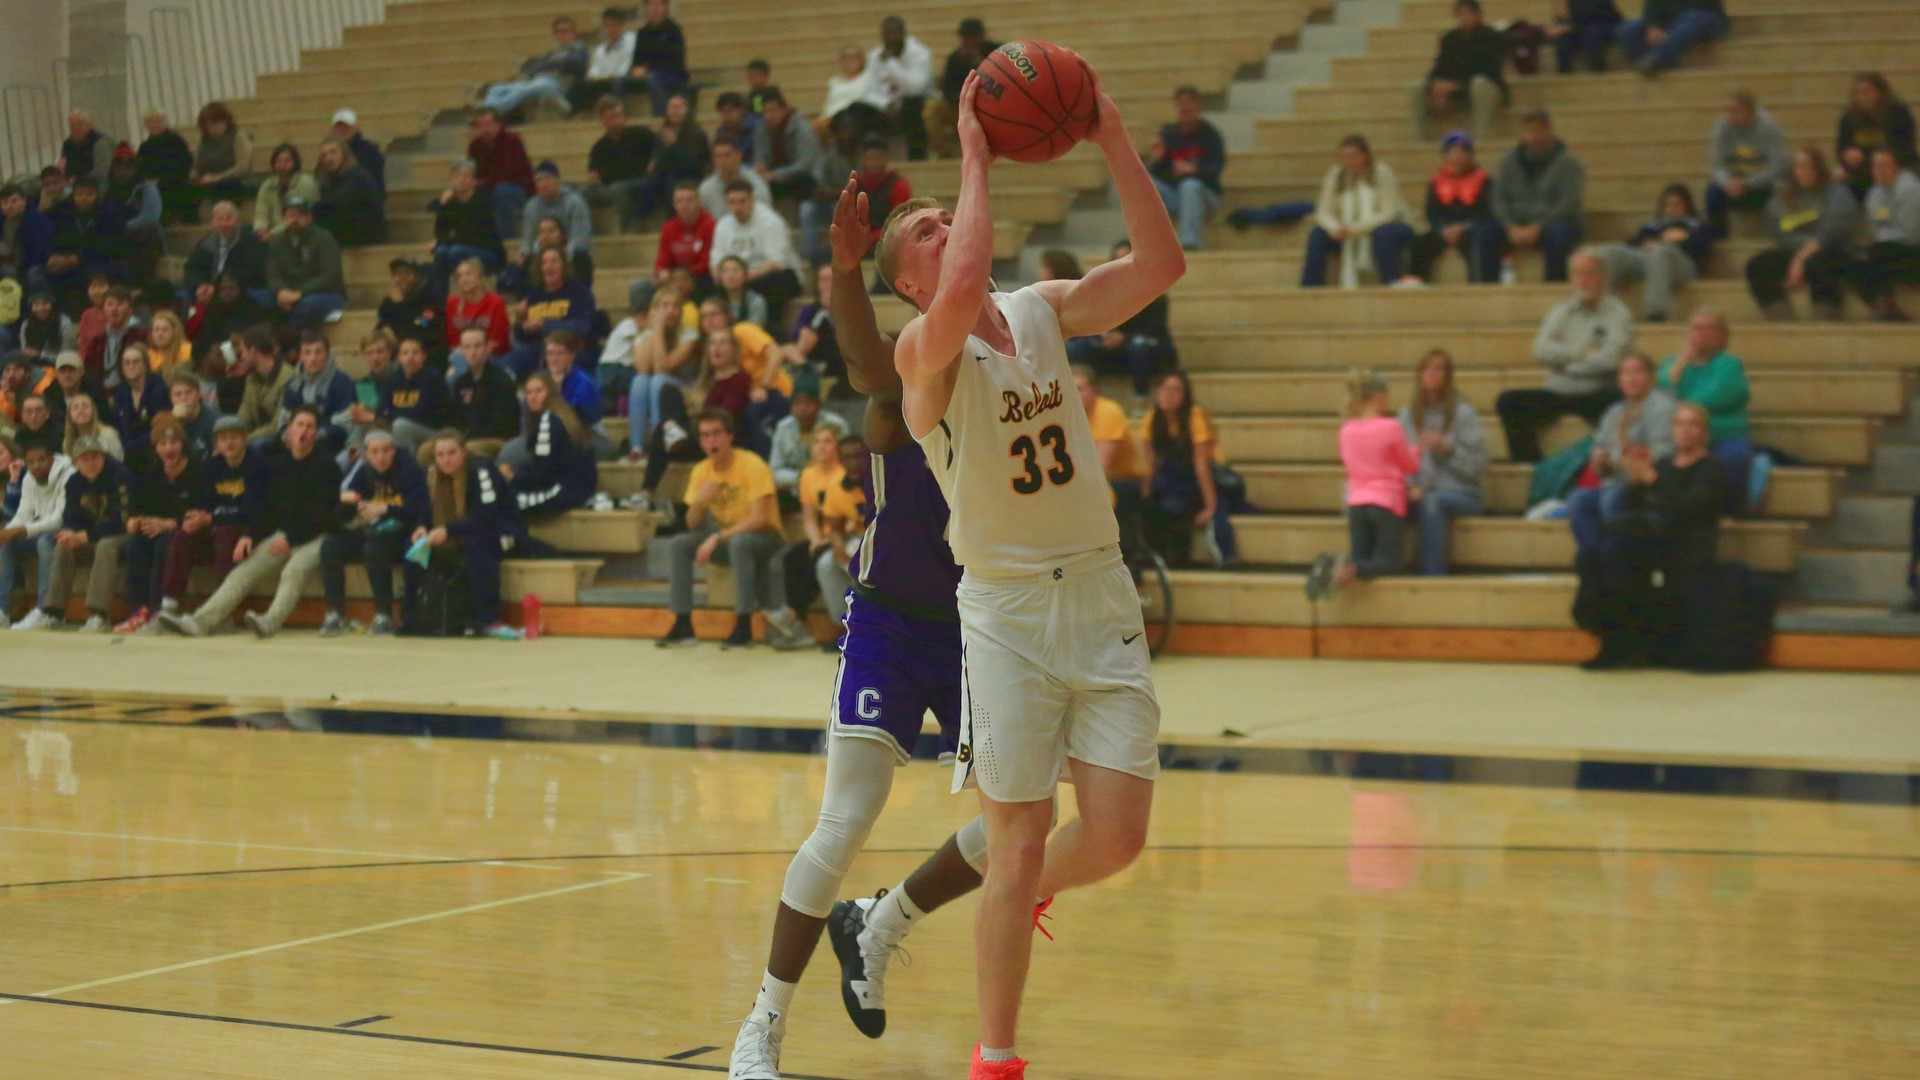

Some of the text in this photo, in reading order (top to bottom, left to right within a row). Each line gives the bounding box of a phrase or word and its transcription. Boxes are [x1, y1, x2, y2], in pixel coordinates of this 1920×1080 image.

[999, 379, 1063, 424] Beloit
[1009, 424, 1075, 497] 33
[855, 686, 883, 721] C
